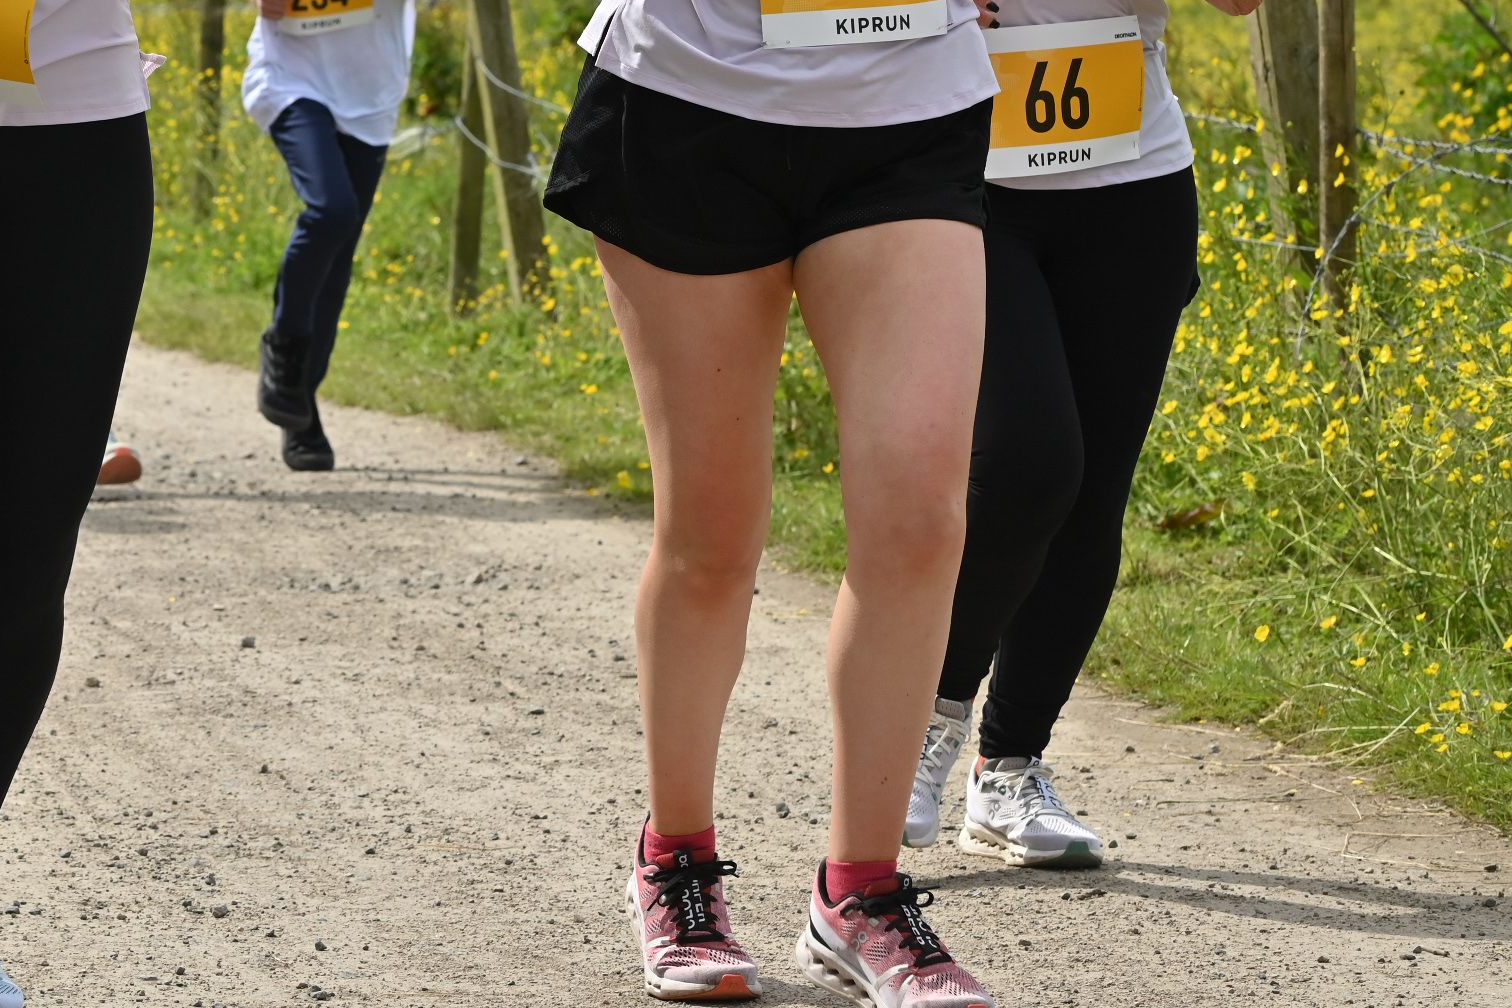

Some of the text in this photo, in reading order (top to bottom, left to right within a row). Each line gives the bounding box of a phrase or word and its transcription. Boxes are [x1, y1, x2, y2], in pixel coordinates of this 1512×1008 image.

[835, 14, 911, 35] KIPRUN
[1025, 58, 1090, 133] 66
[1027, 147, 1092, 168] KIPRUN
